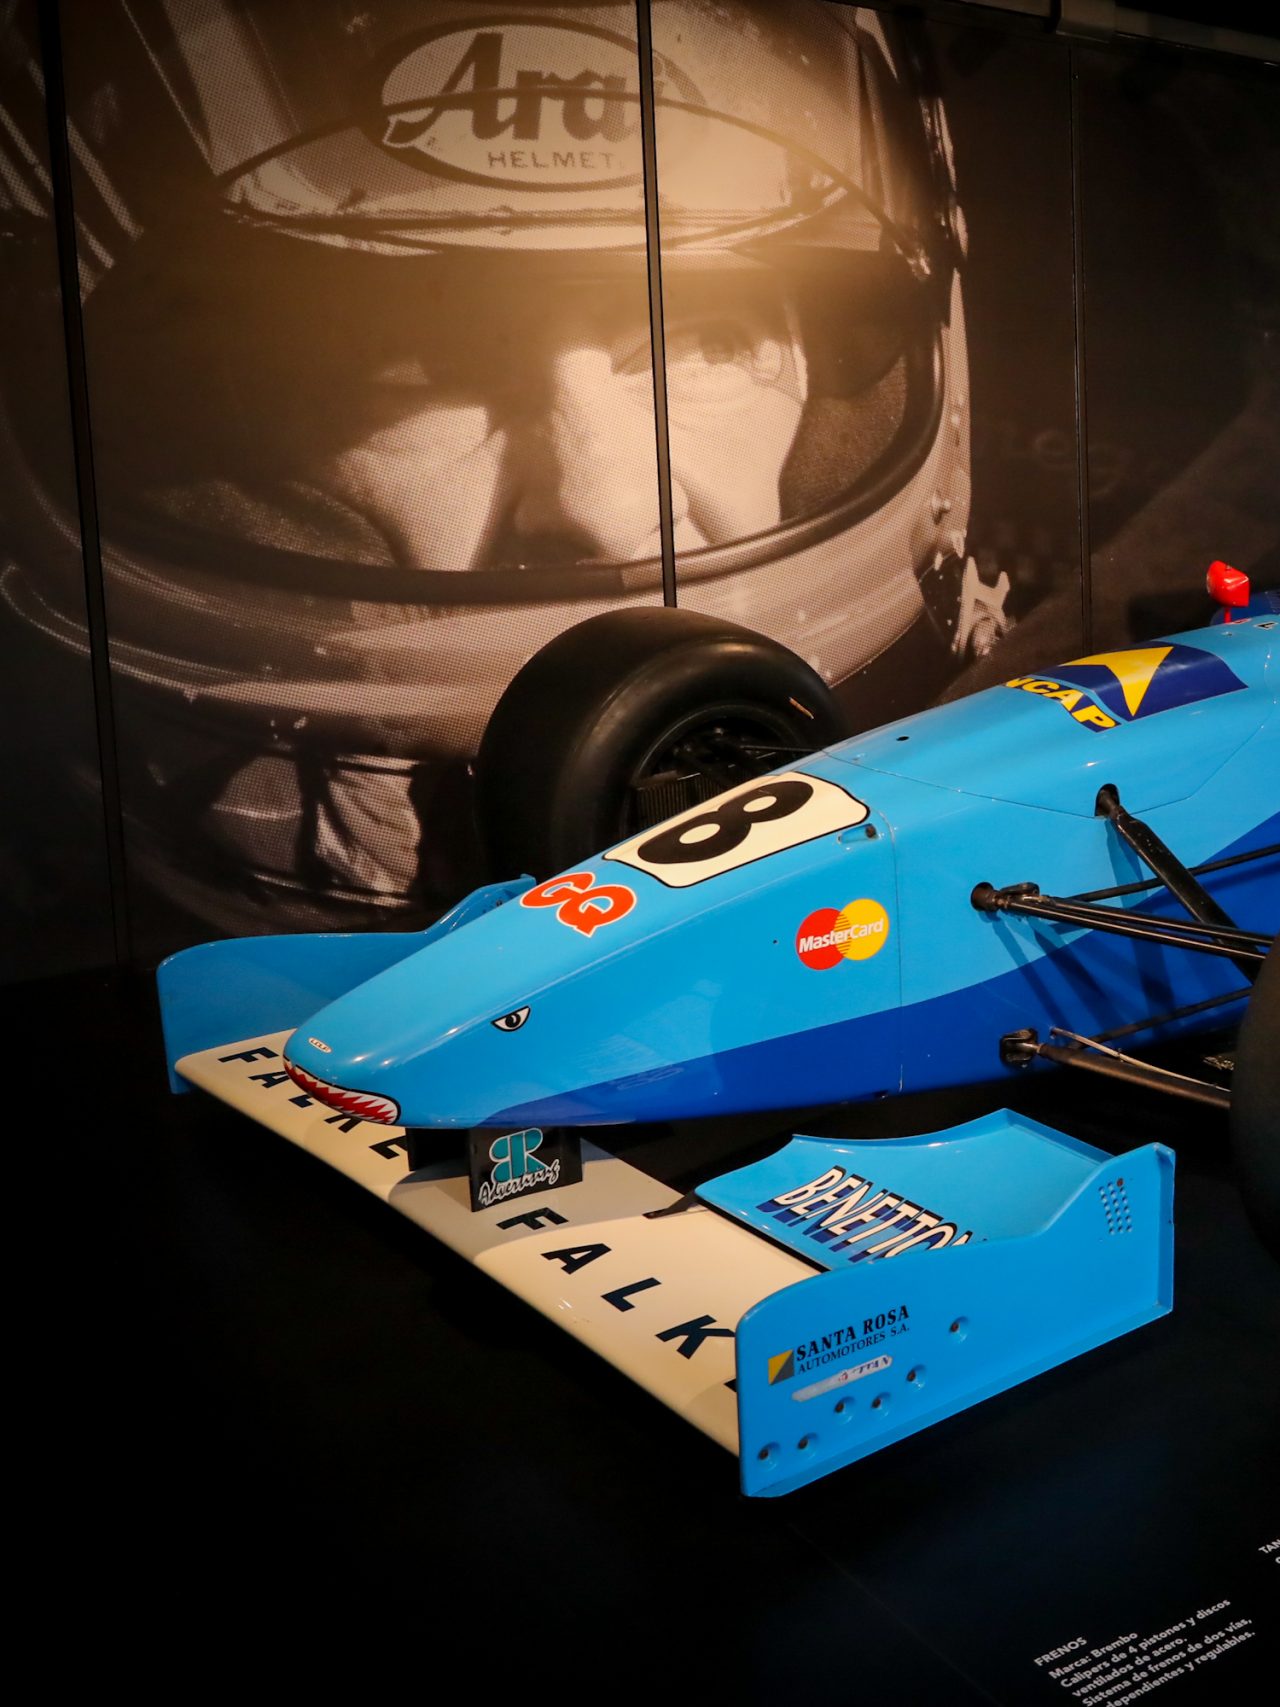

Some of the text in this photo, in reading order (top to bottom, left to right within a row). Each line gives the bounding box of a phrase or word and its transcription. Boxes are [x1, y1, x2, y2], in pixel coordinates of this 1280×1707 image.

[487, 150, 617, 170] HELMET
[637, 780, 814, 865] 8
[519, 871, 637, 938] GQ
[798, 918, 885, 954] MasterCard
[760, 1164, 973, 1262] BENETTO
[495, 1206, 737, 1393] FALK
[796, 1304, 910, 1362] SANTA ROSA
[798, 1322, 910, 1374] AUTOMOTORES S.A.
[1034, 1637, 1088, 1667] FRENOS
[1048, 1633, 1138, 1679] Marca: Brembo
[1060, 1600, 1231, 1688] Calipers de 4 pistones y discos
[1072, 1638, 1188, 1697] ventilados de acero.
[1082, 1619, 1253, 1707] Sistema de frenos de dos vías,
[1184, 1661, 1195, 1672] y
[1194, 1632, 1256, 1665] regulables.
